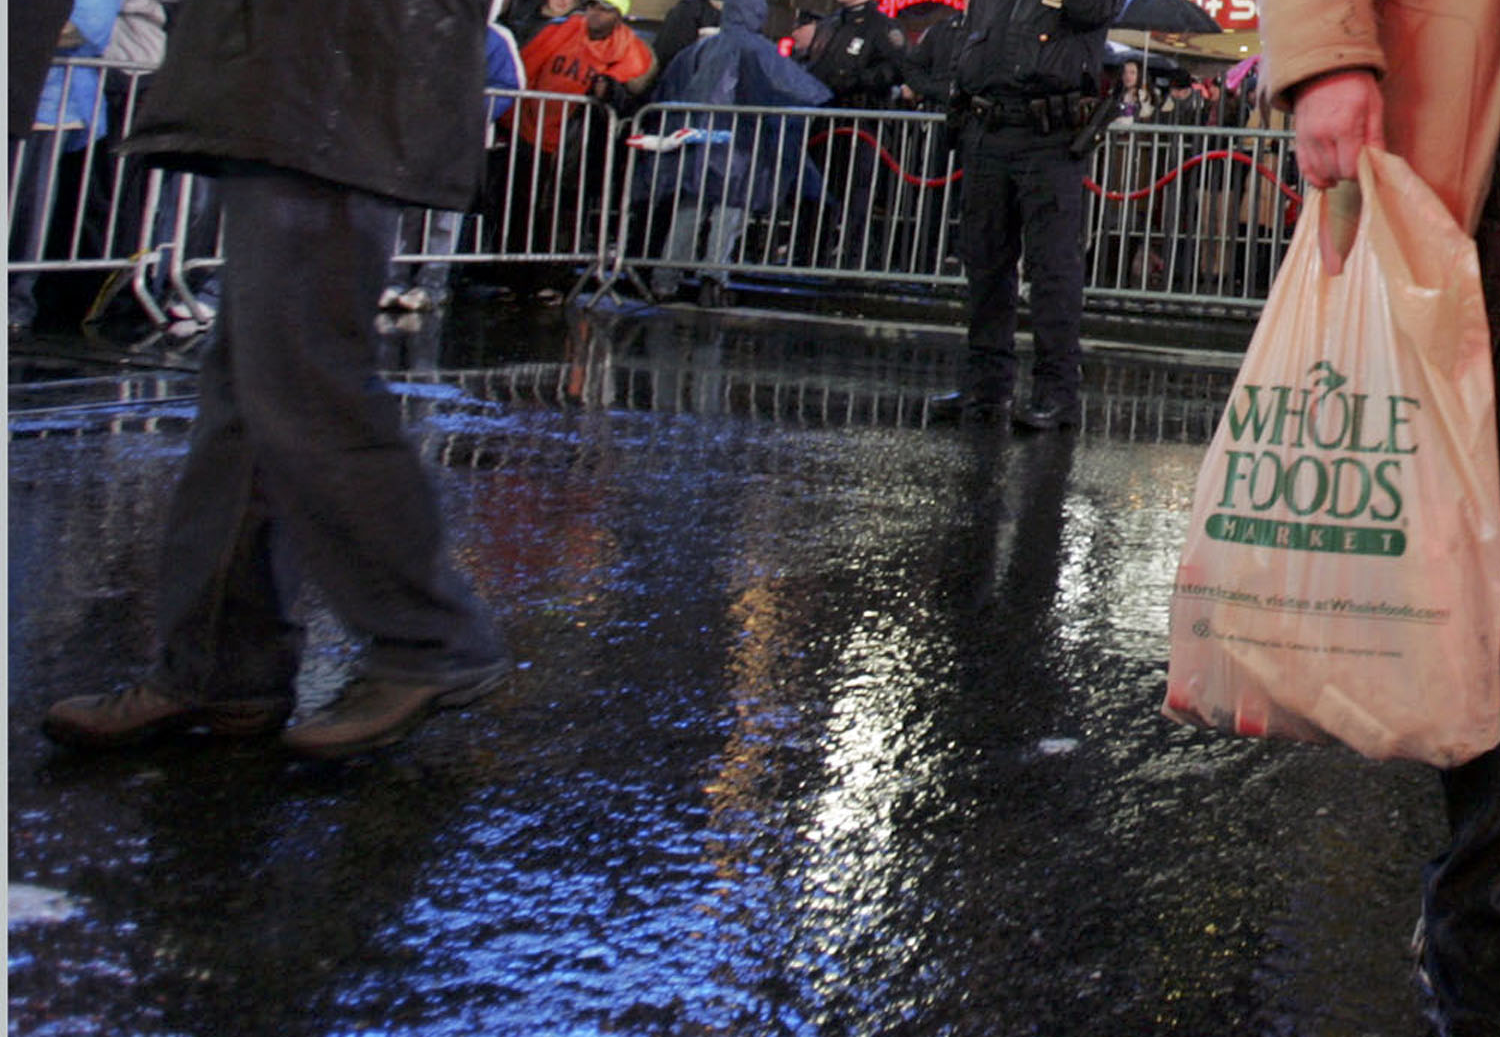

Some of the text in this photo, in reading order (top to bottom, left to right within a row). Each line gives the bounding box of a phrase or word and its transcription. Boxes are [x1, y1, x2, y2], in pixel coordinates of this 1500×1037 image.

[1228, 384, 1421, 455] WHOLE
[1217, 450, 1404, 522] FOODS
[1221, 520, 1395, 552] MARKET
